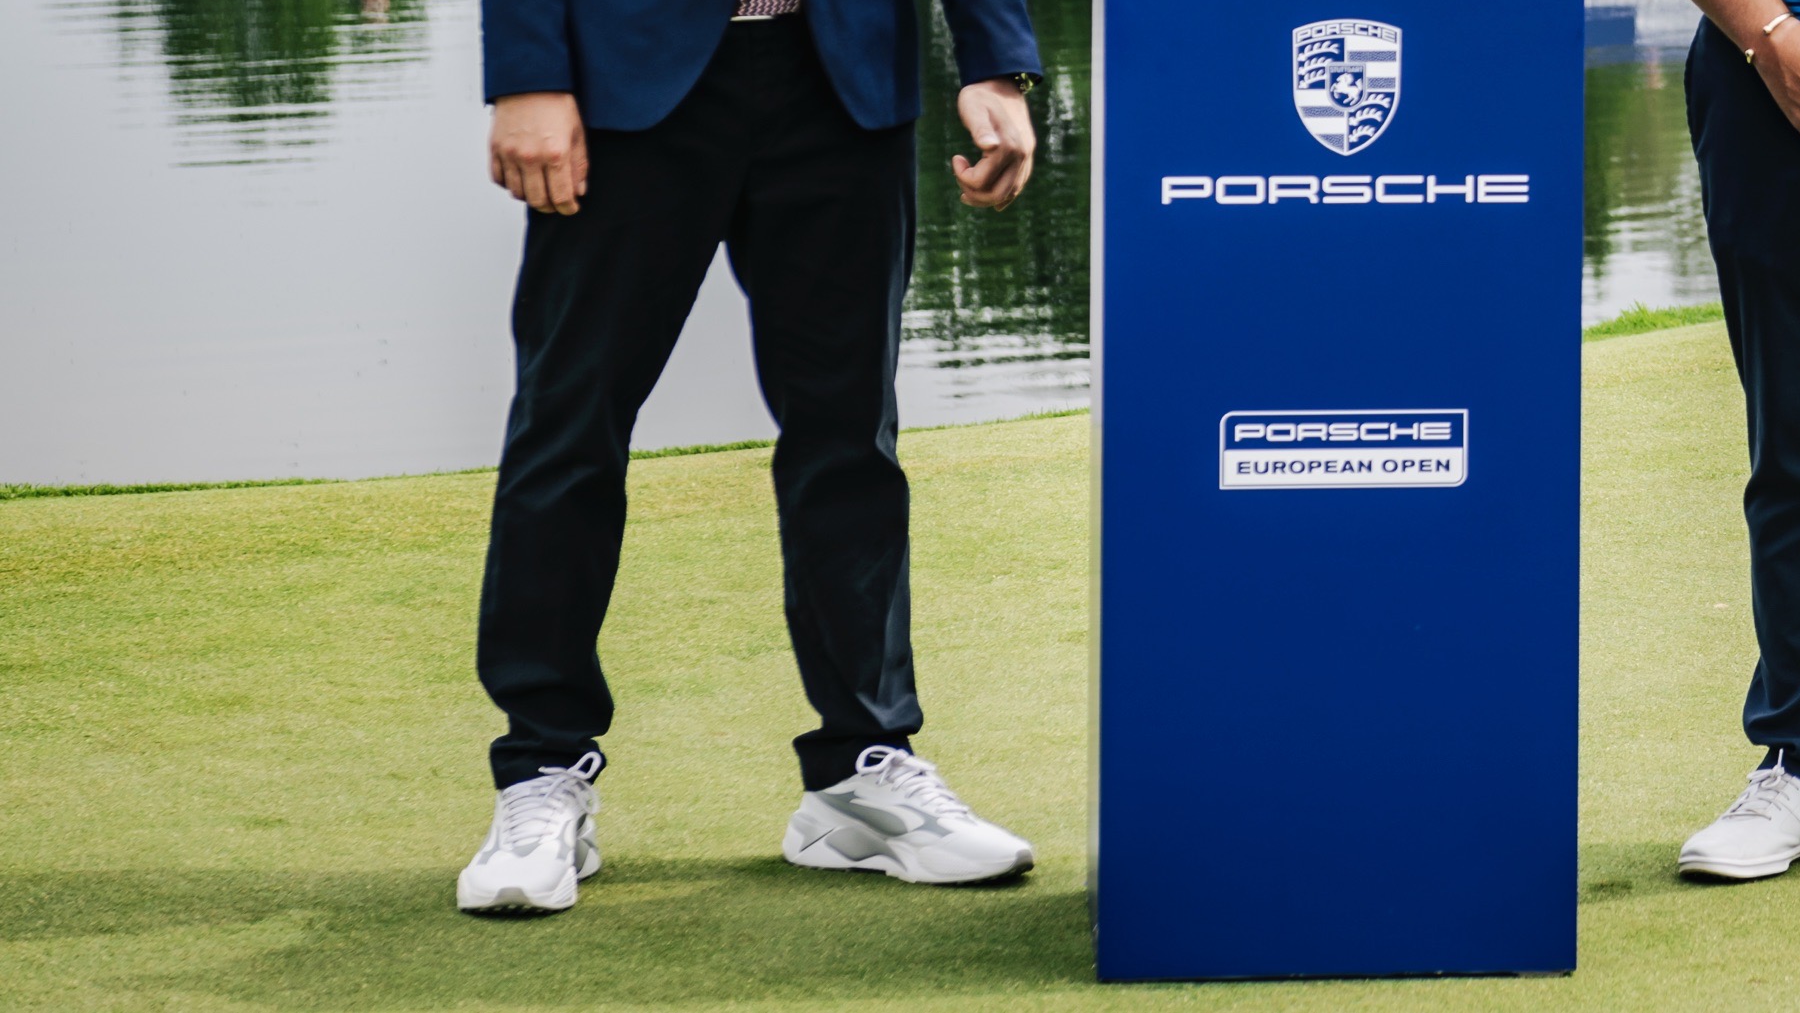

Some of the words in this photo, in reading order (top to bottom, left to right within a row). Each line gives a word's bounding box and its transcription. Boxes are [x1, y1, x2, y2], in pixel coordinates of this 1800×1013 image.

[1296, 22, 1397, 44] PORSCHE
[1161, 174, 1530, 205] PORSCHE
[1234, 421, 1452, 443] PORSCHE
[1236, 459, 1372, 475] EUROPEAN
[1382, 458, 1451, 473] OPEN
